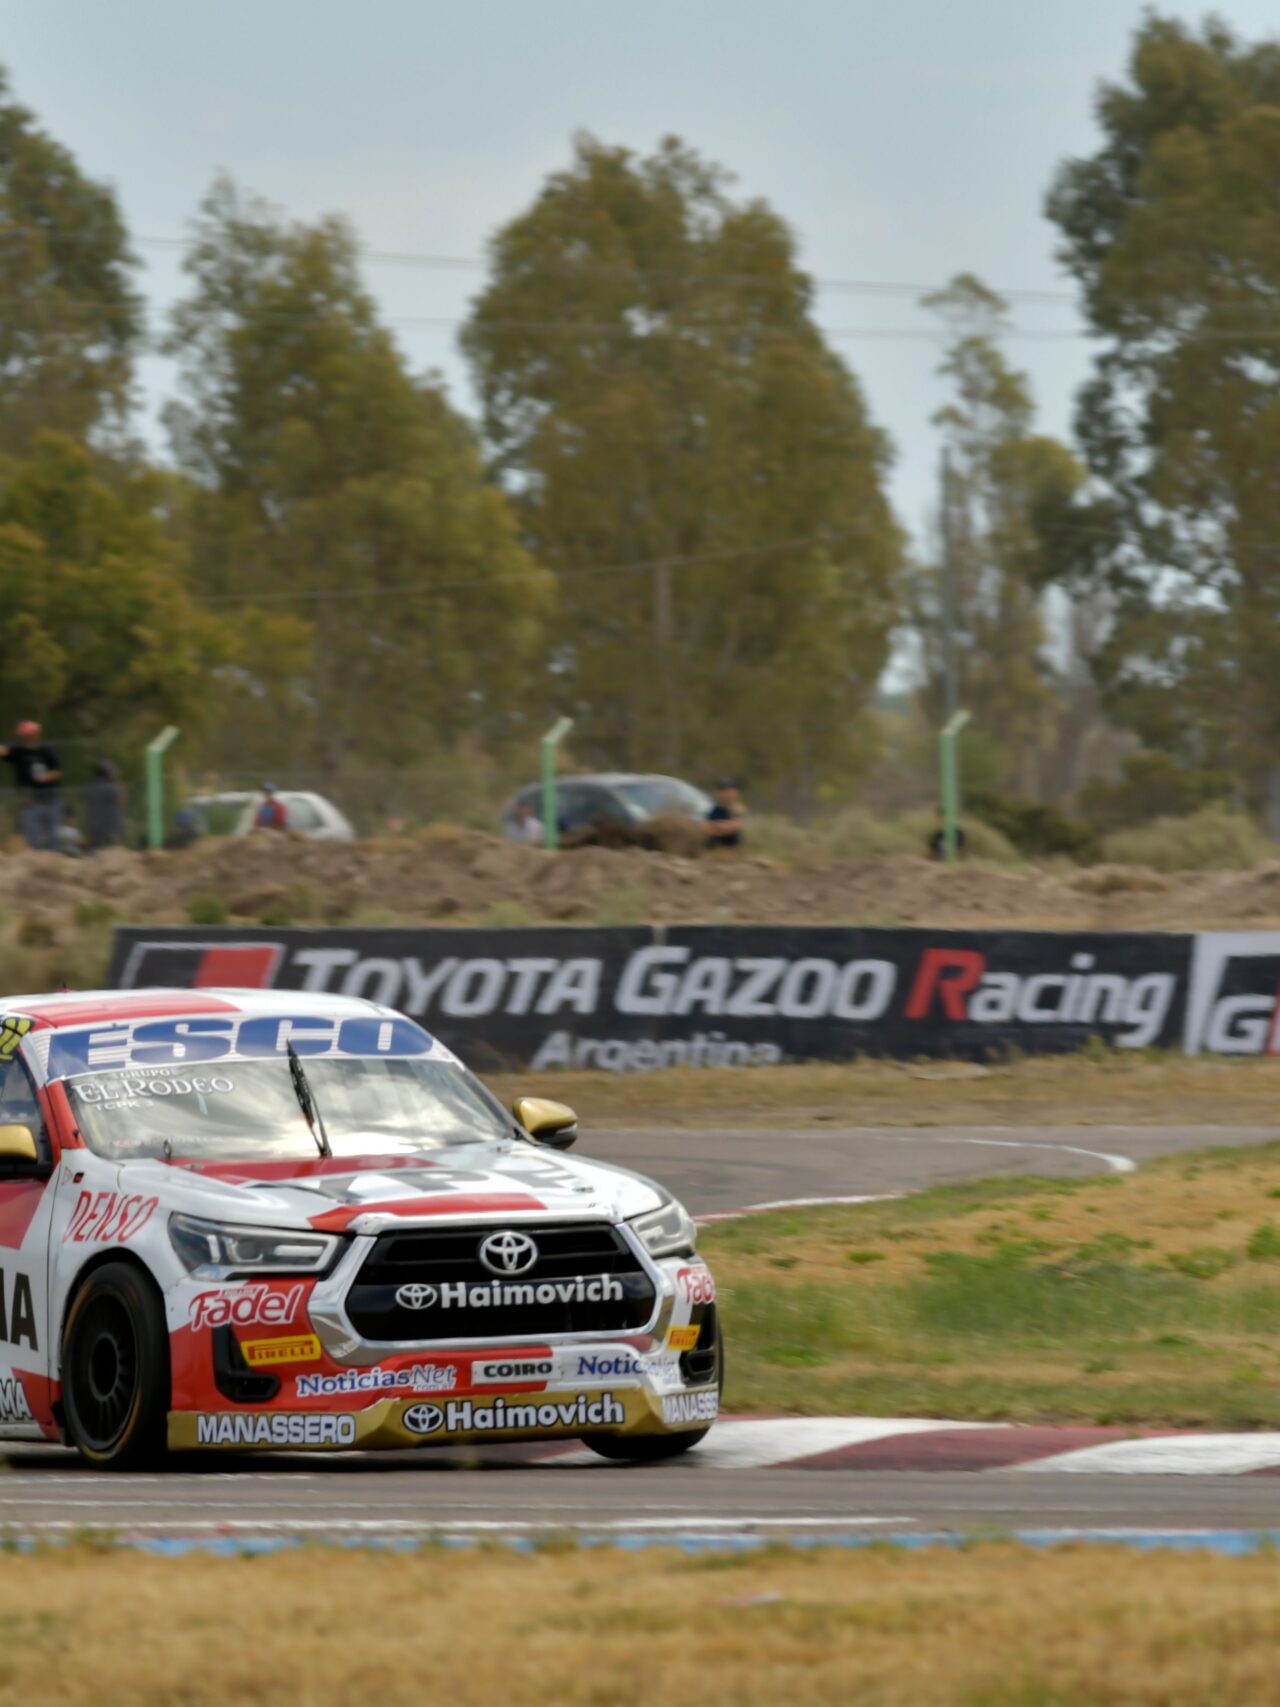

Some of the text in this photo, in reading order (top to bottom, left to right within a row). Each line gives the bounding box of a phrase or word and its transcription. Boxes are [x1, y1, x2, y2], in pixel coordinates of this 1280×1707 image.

[293, 945, 1176, 1048] TOYOTA GAZOO Racing
[47, 1016, 434, 1081] ESCO
[530, 1031, 783, 1069] Argentina
[72, 1077, 234, 1103] EL RODEO
[120, 1069, 170, 1078] GRUPO
[62, 1191, 160, 1244] DENSO
[188, 1284, 304, 1331] Fadel
[440, 1273, 623, 1308] Haimovich
[247, 1340, 314, 1360] PIRELLI
[483, 1362, 553, 1378] COIRO
[197, 1414, 357, 1444] MANASSERO
[446, 1393, 625, 1431] Haimovich
